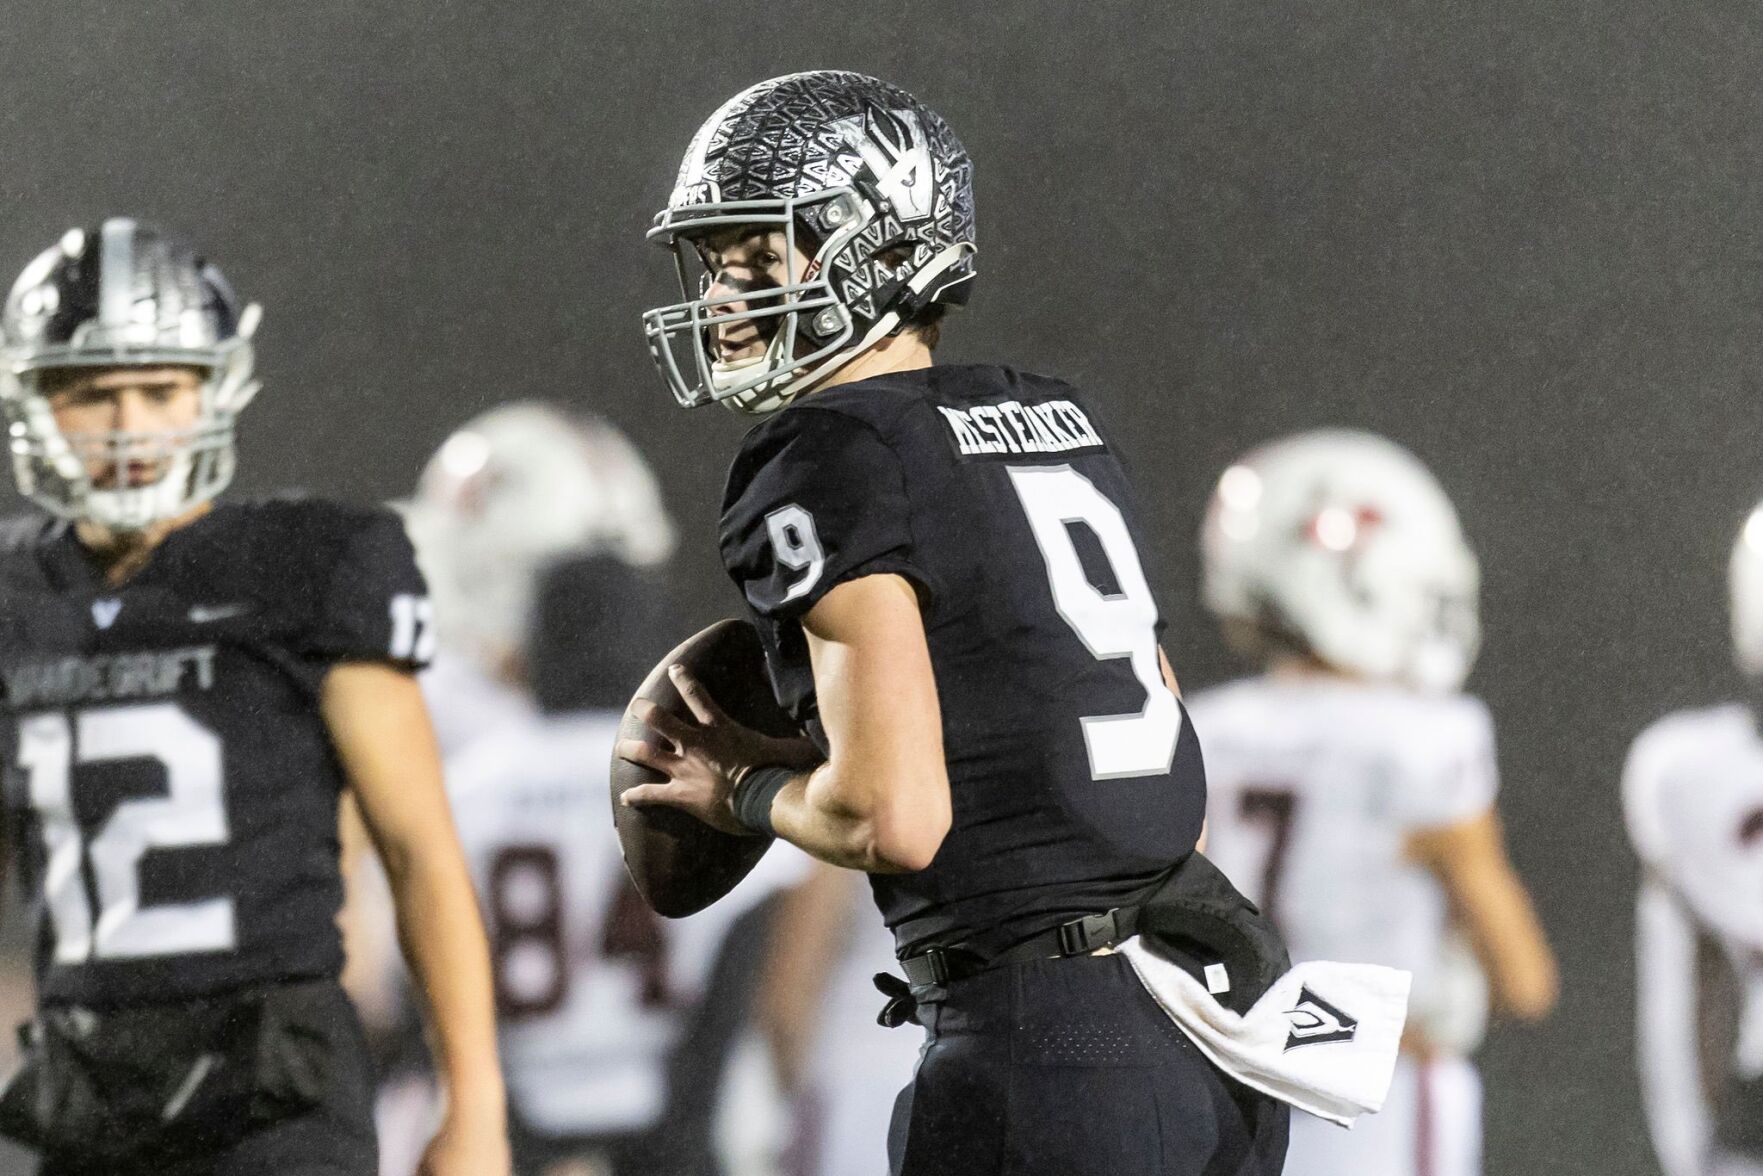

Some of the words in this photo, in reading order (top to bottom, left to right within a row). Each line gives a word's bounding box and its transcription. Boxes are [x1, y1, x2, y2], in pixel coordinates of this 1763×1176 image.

[389, 594, 433, 660] 12
[764, 503, 825, 604] 9
[1005, 463, 1182, 781] 9
[17, 703, 236, 965] 12
[1240, 786, 1295, 914] 7
[488, 846, 670, 1020] 84
